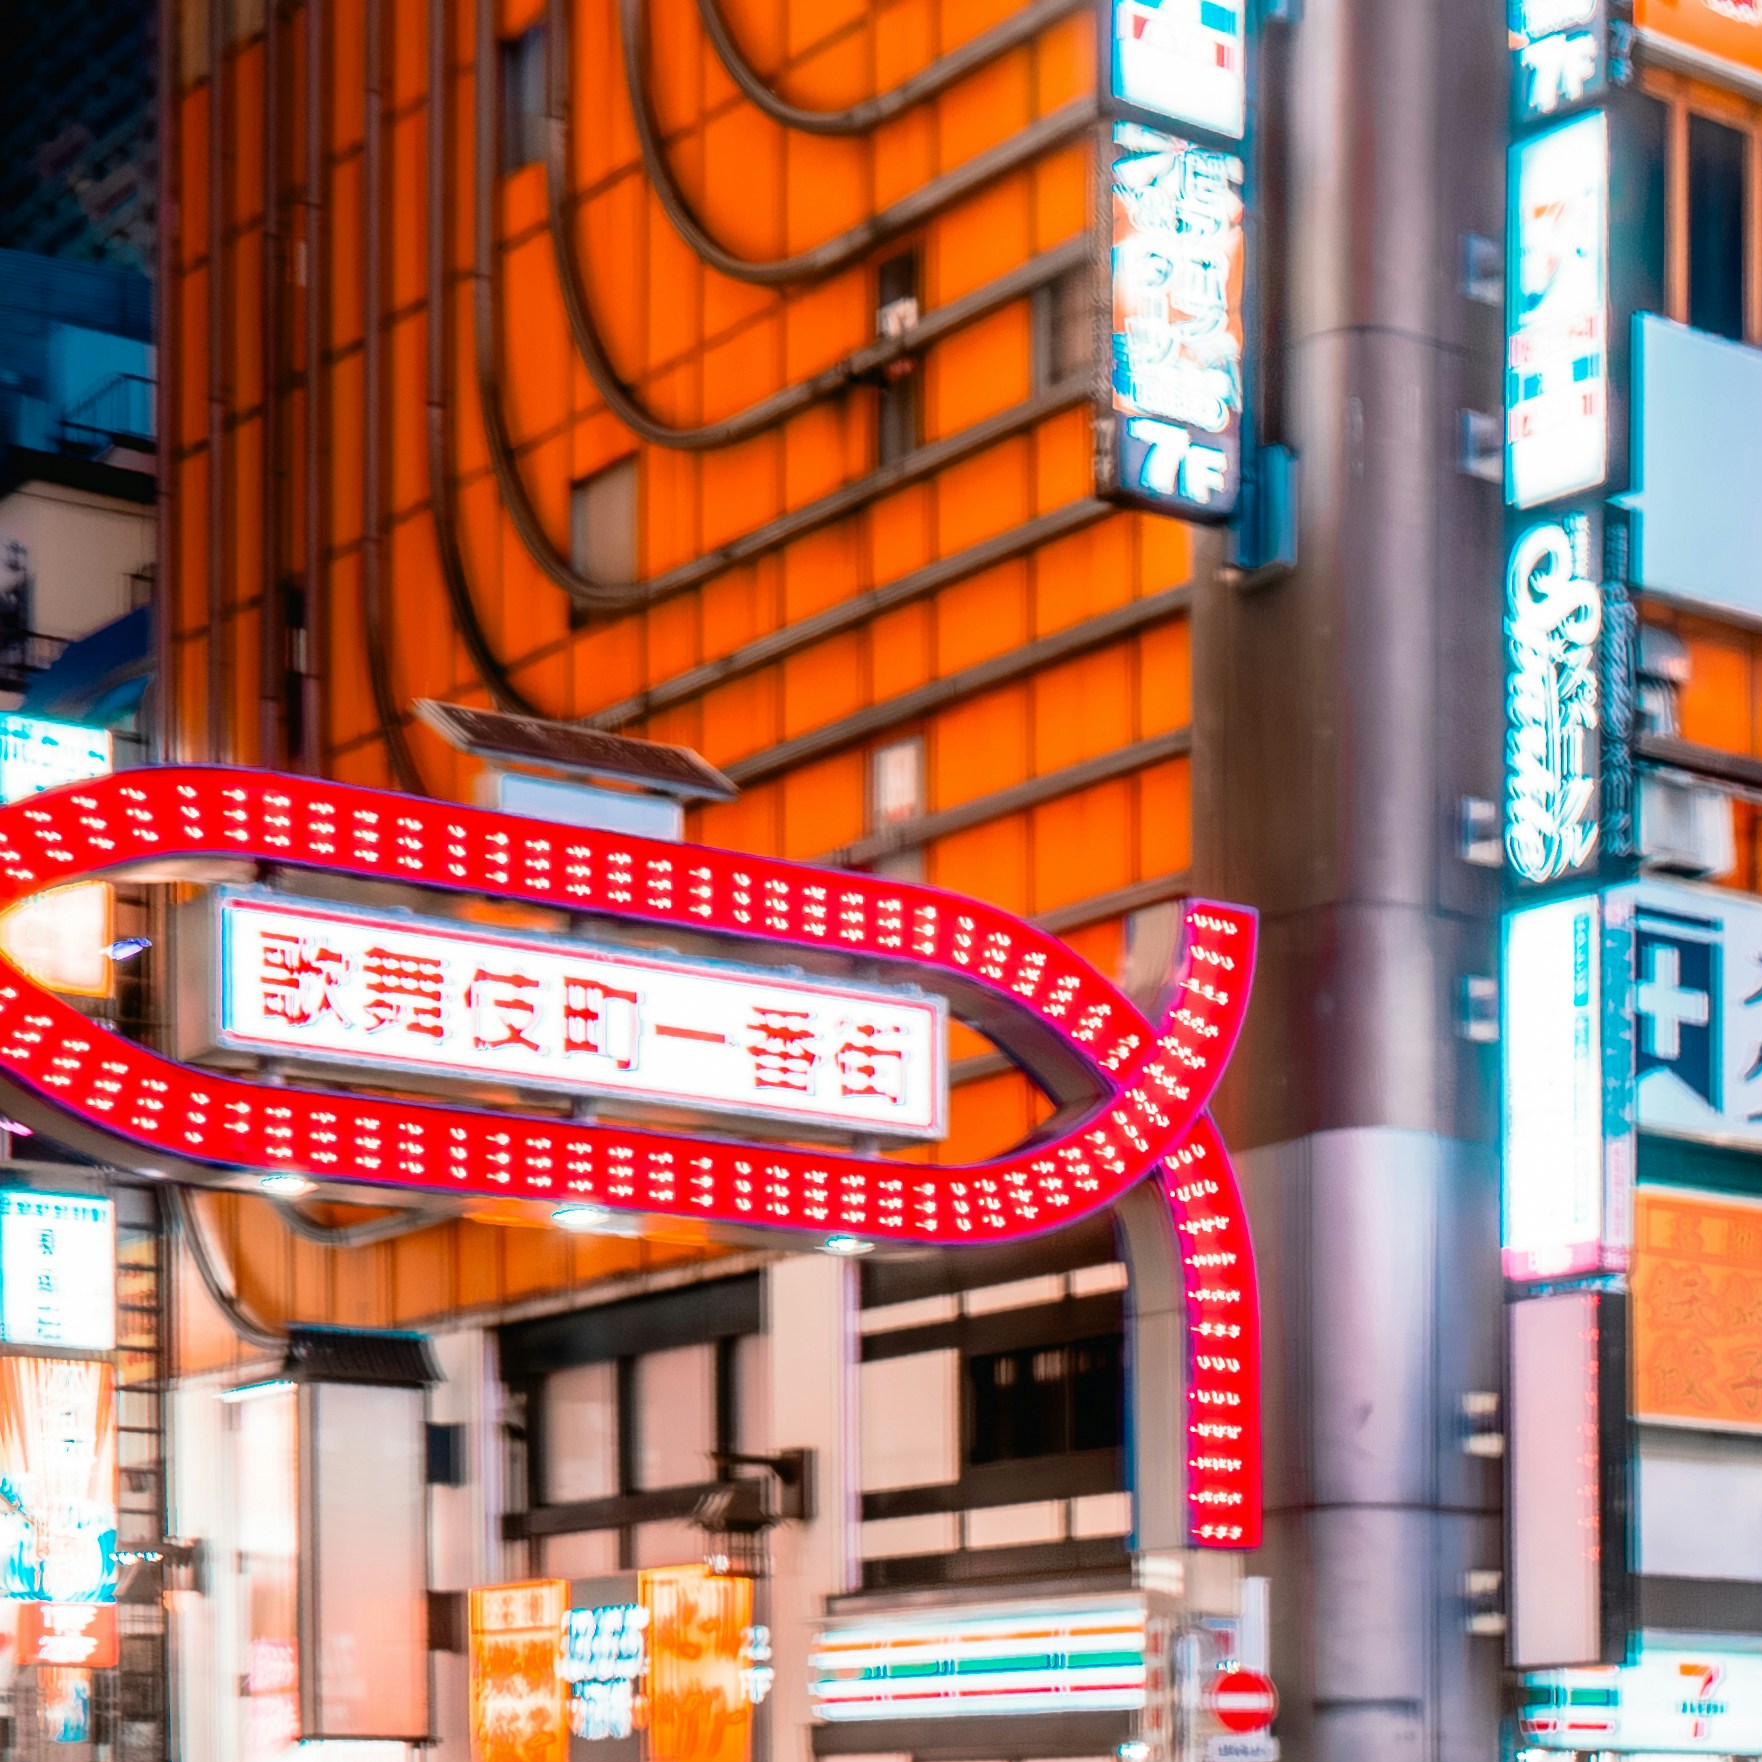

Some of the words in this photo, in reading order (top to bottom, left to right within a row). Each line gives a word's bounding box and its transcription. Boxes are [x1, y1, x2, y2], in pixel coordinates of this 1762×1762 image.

[1127, 415, 1229, 505] 7F
[259, 930, 911, 1104] 歌舞伎町一番街
